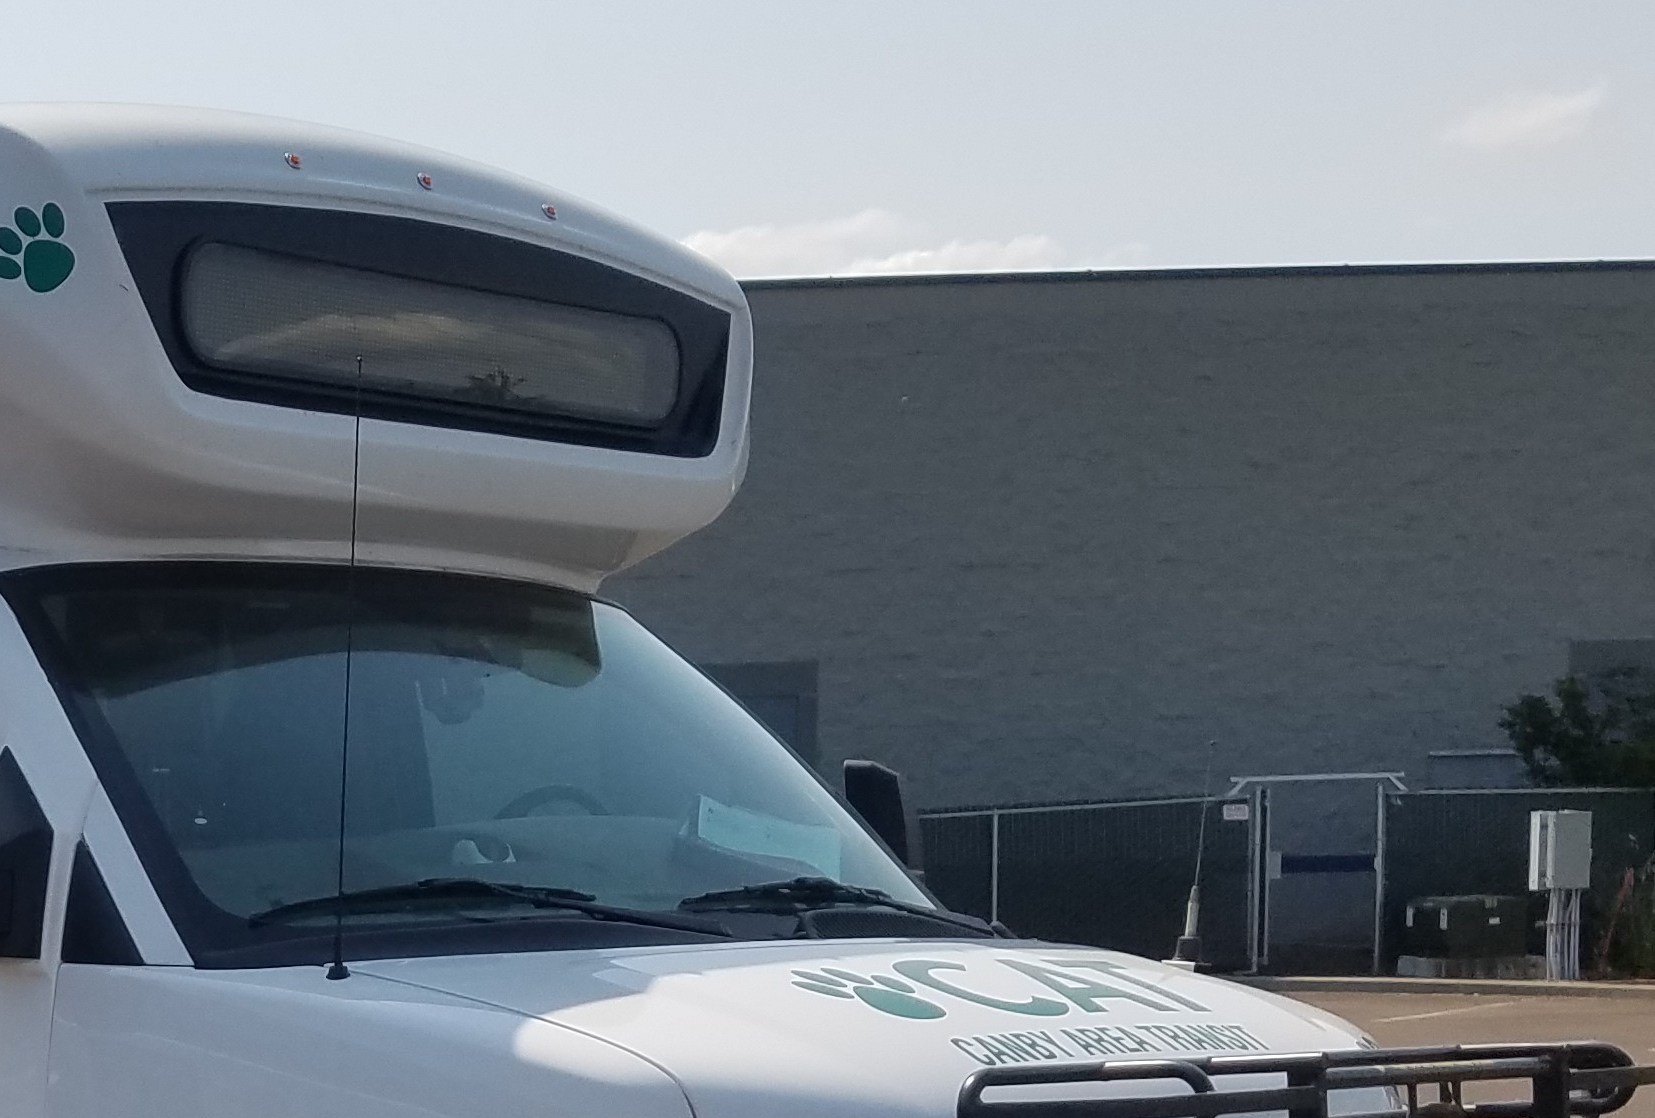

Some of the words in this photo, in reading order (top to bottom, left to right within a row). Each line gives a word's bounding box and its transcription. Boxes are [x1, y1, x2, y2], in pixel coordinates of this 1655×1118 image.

[892, 959, 1212, 1017] CAT
[950, 1031, 1075, 1066] CANBY
[1060, 1025, 1162, 1057] AREA
[1134, 1024, 1270, 1051] TRANSIT
